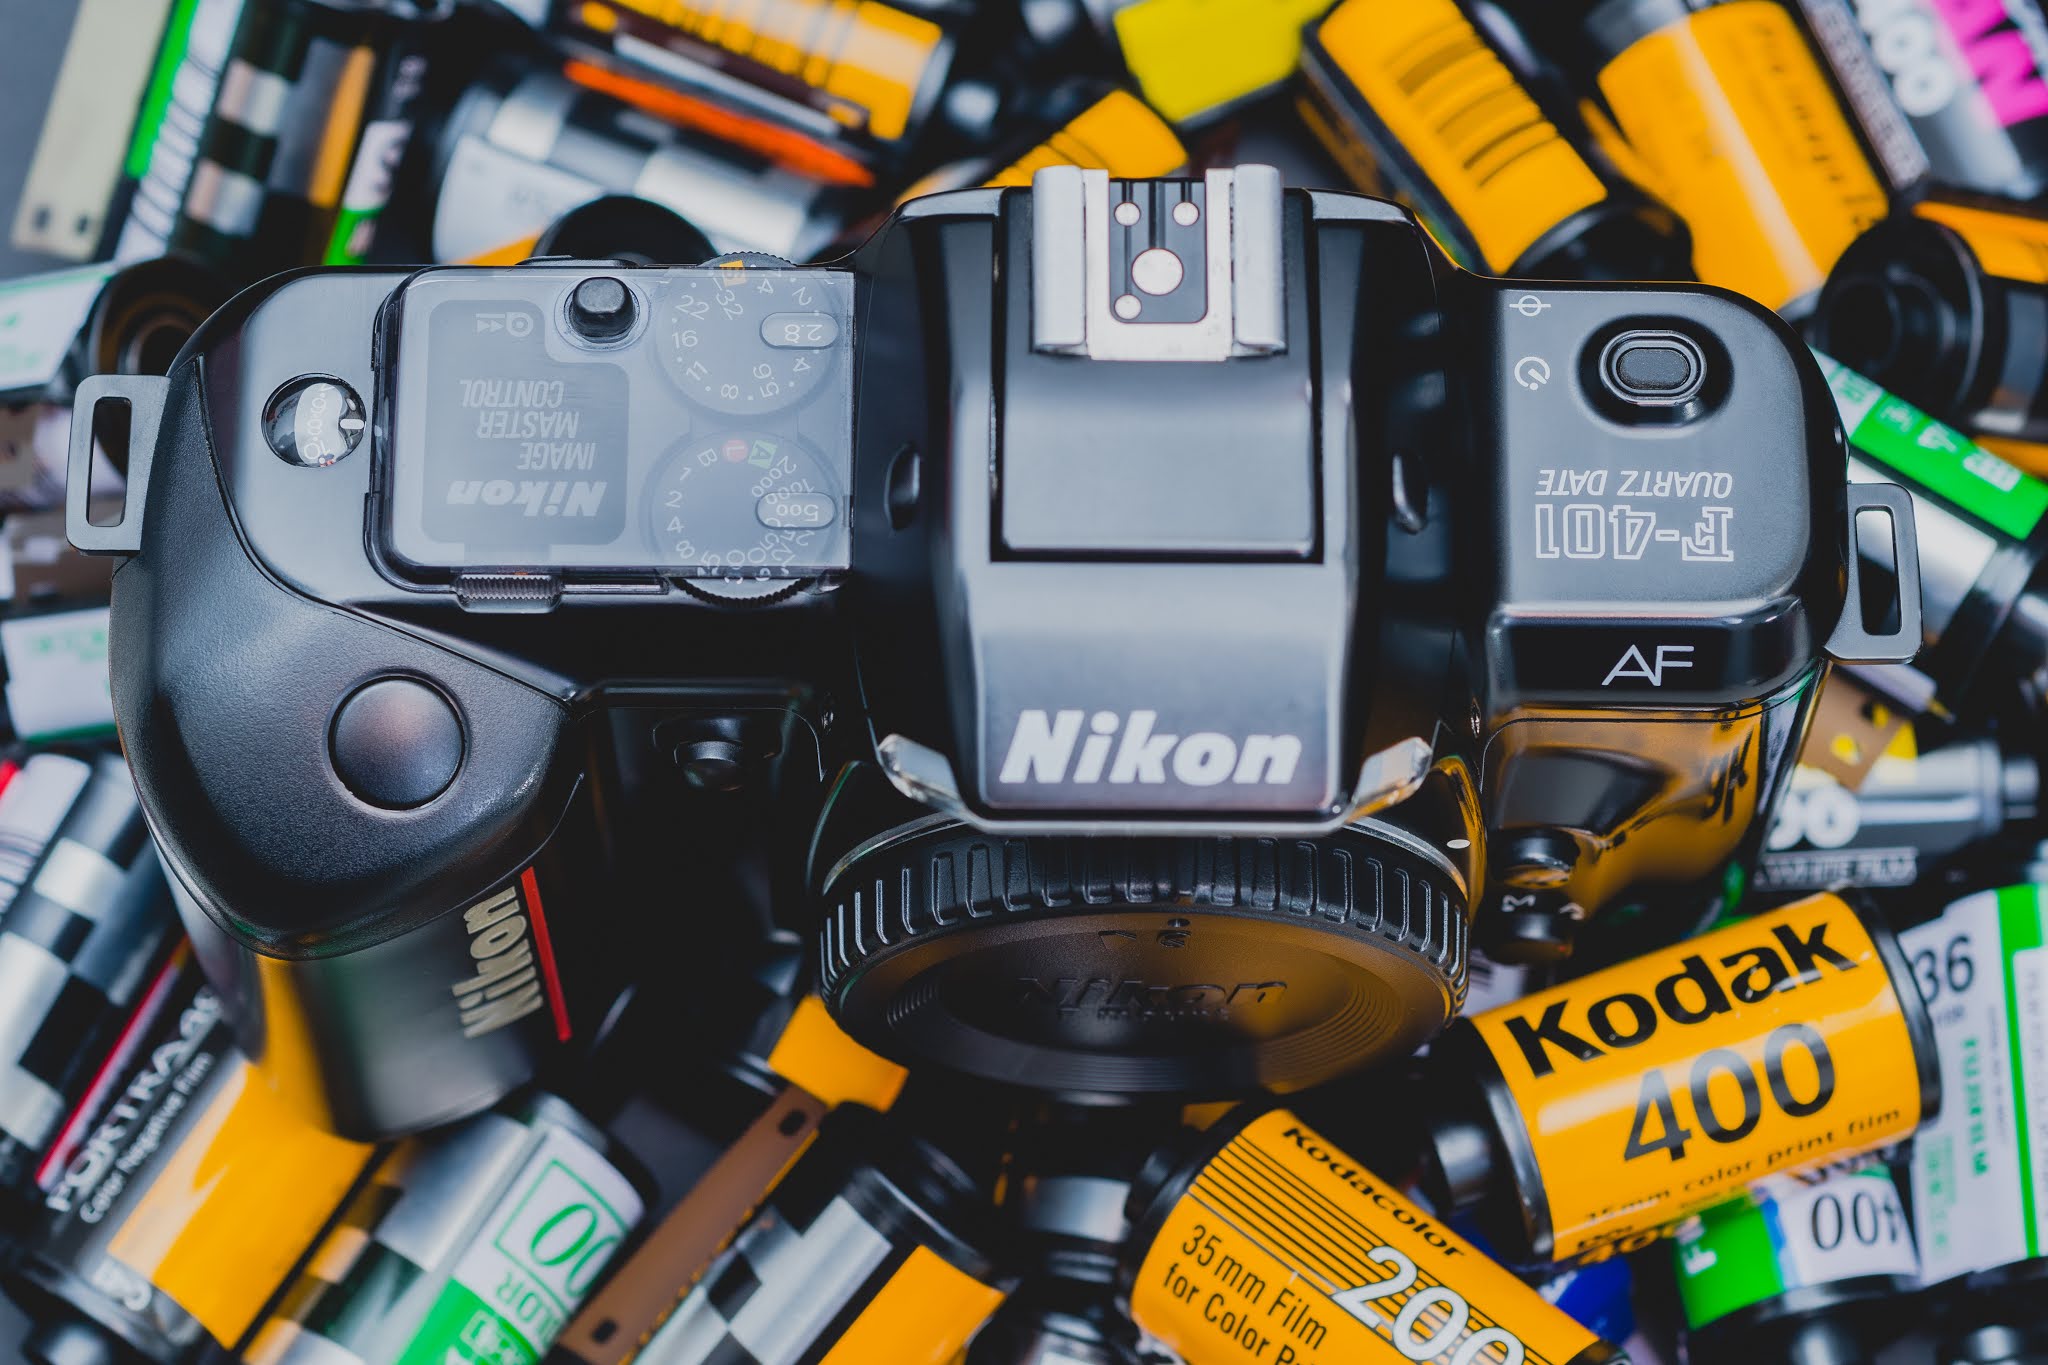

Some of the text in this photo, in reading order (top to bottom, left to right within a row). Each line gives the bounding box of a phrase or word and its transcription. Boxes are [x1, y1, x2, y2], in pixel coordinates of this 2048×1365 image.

[674, 294, 710, 321] 22
[715, 288, 744, 320] 32
[791, 286, 813, 307] 2
[671, 329, 698, 349] 16
[783, 323, 824, 344] 2.8
[685, 360, 708, 382] 11
[792, 356, 811, 374] 4
[457, 378, 565, 408] CONTROL
[720, 382, 740, 401] 8
[476, 410, 580, 439] MASTER
[515, 441, 597, 471] IMAGE
[696, 447, 718, 467] B
[679, 466, 692, 481] 1
[751, 455, 797, 498] 2000
[1535, 469, 1734, 498] QUARTZ DATE
[445, 479, 608, 517] Nikon
[663, 490, 682, 509] 2
[775, 503, 820, 522] 500
[665, 515, 684, 533] 4
[1535, 503, 1735, 562] F-401
[675, 539, 697, 559] 8
[1601, 644, 1695, 687] AF
[998, 709, 1303, 786] Nikon
[451, 885, 544, 1040] Nikon
[1914, 934, 1975, 1006] 36
[1504, 922, 1859, 1079] Kodak
[1624, 1022, 1836, 1162] 400
[1683, 1161, 1752, 1193] color
[1765, 1132, 1835, 1168] print
[1847, 1110, 1900, 1137] film
[1281, 1126, 1466, 1259] Kodacolor
[1163, 1261, 1201, 1304] for
[1202, 1292, 1272, 1358] Color
[1331, 1245, 1527, 1365] 200
[1267, 1291, 1329, 1352] Film
